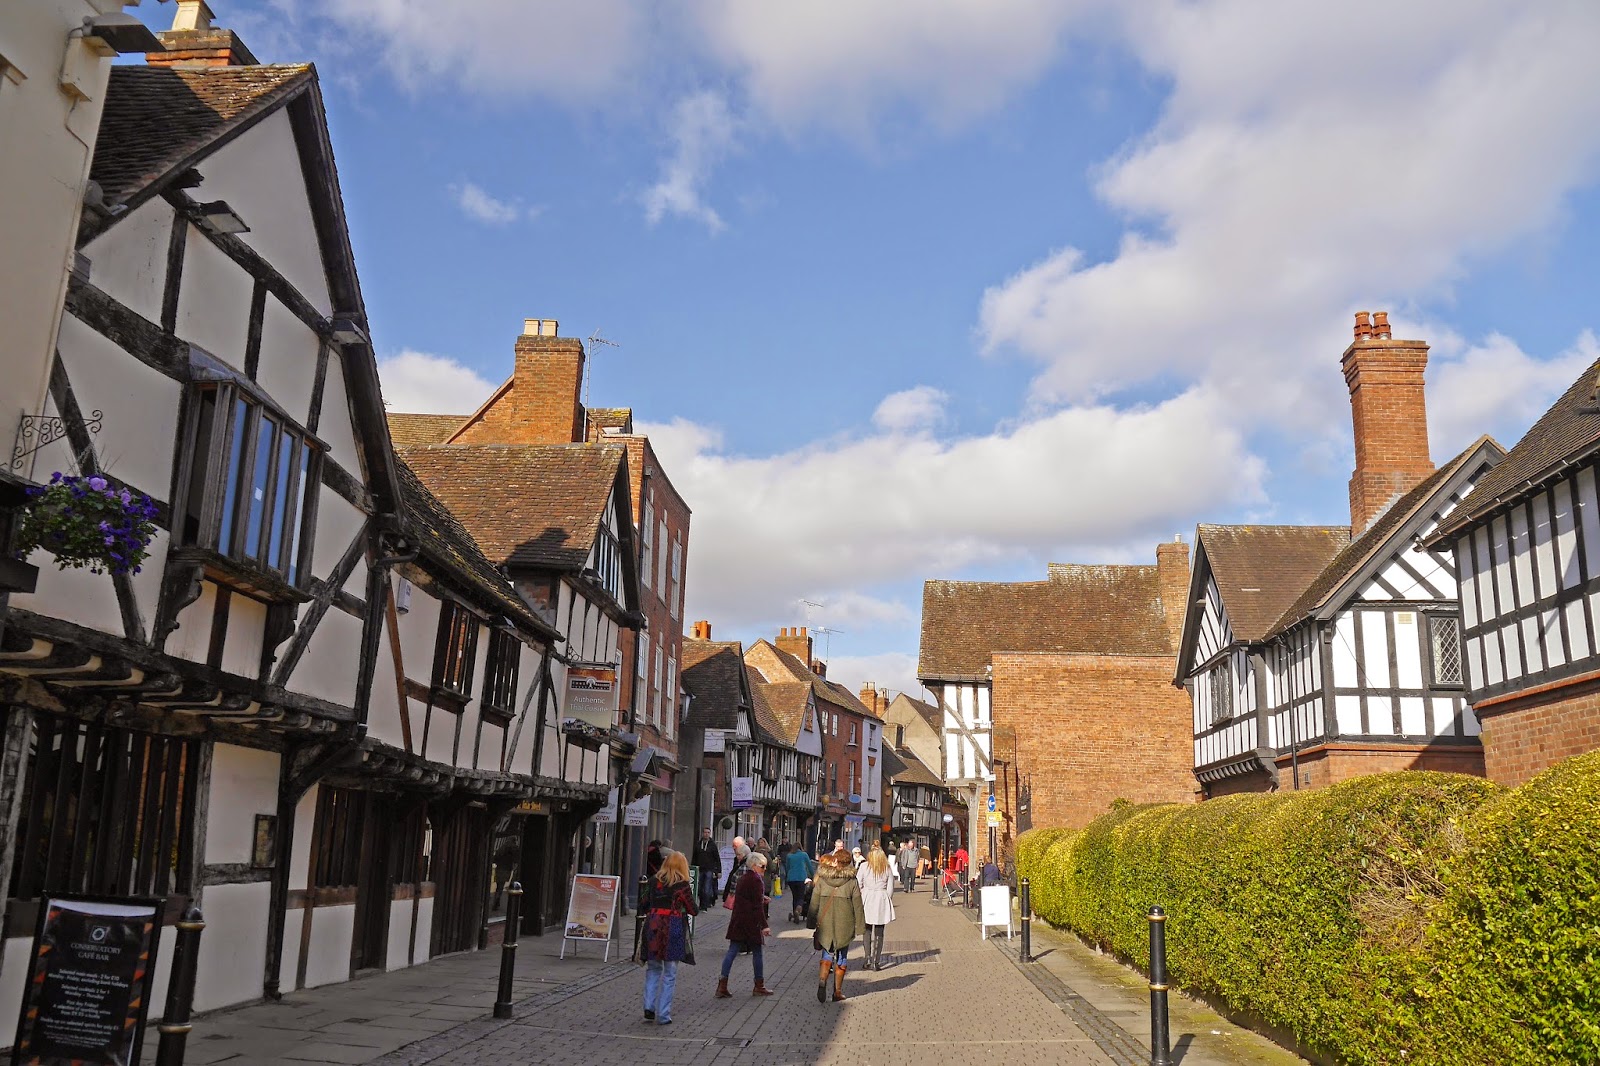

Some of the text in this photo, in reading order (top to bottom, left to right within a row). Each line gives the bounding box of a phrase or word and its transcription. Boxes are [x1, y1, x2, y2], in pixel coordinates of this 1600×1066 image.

[574, 696, 606, 704] Authentic
[70, 942, 122, 954] CONSERVATORY
[78, 951, 95, 959] CAFÉ
